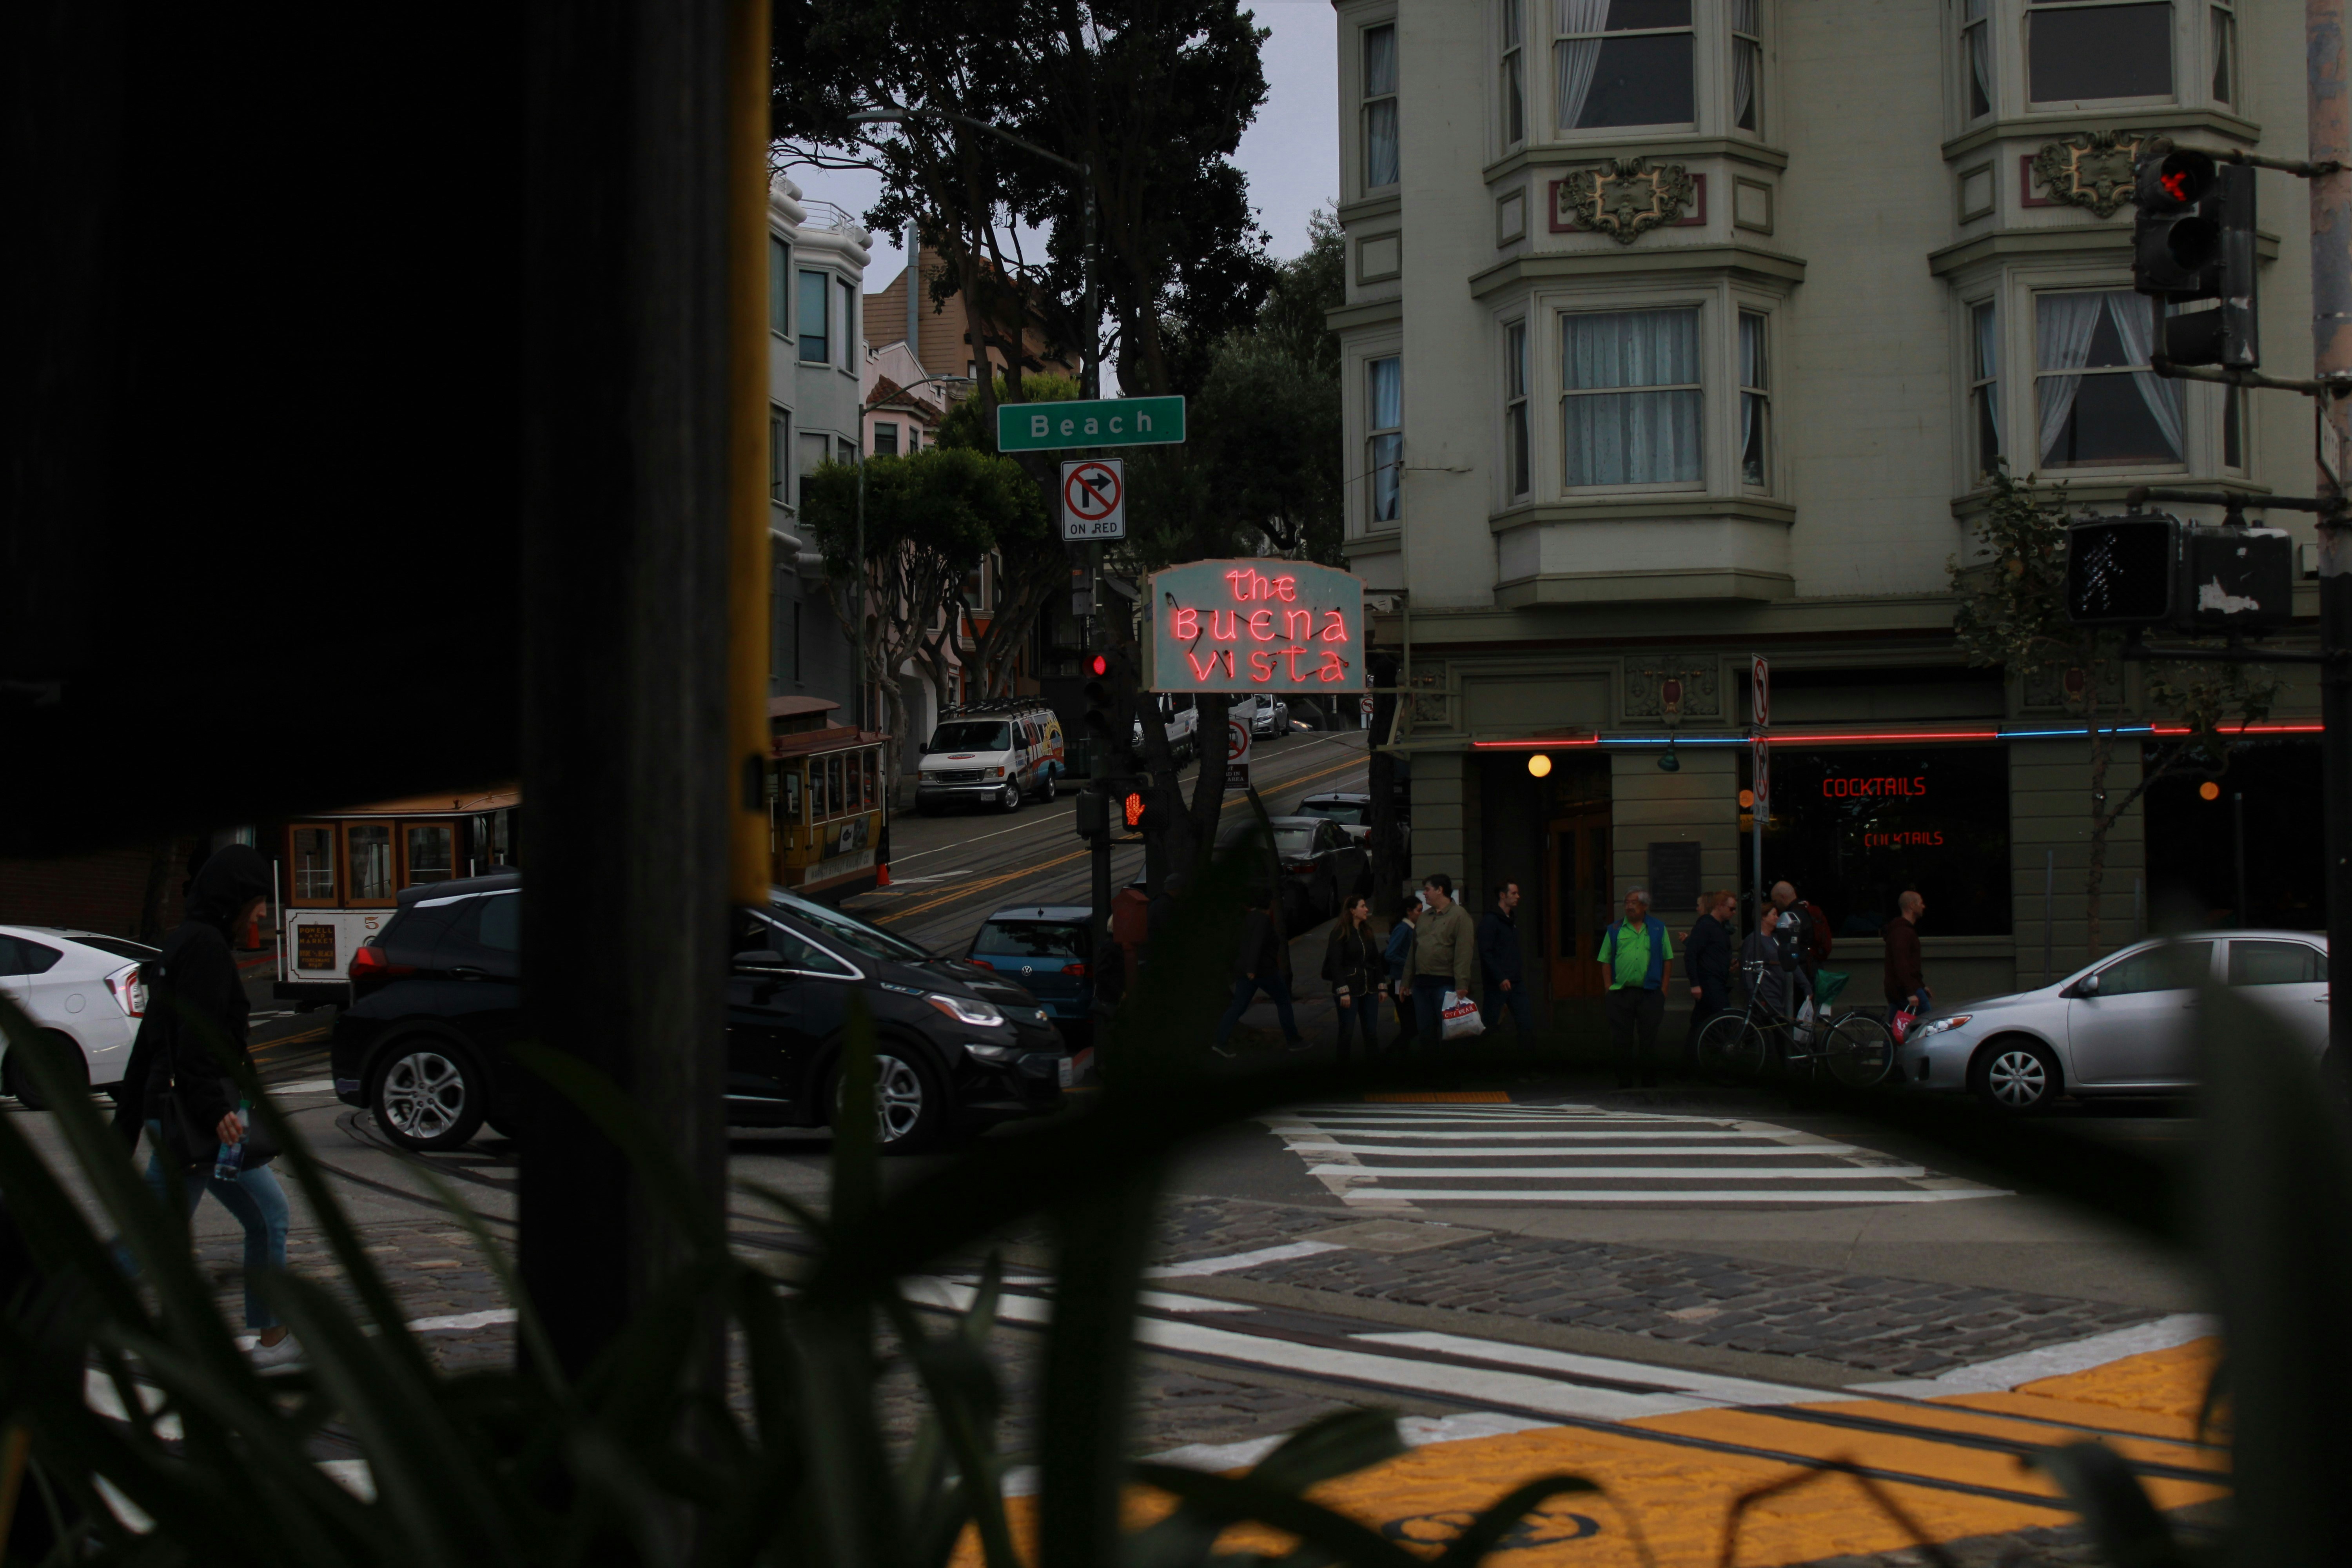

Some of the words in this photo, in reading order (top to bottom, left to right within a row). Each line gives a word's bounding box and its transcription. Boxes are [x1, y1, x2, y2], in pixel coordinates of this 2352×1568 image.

[1031, 410, 1152, 437] Beach
[1071, 524, 1085, 535] ON
[1094, 523, 1117, 534] RED
[1226, 568, 1296, 602] the
[1823, 777, 1926, 797] COCKTAILS
[365, 916, 379, 929] 5
